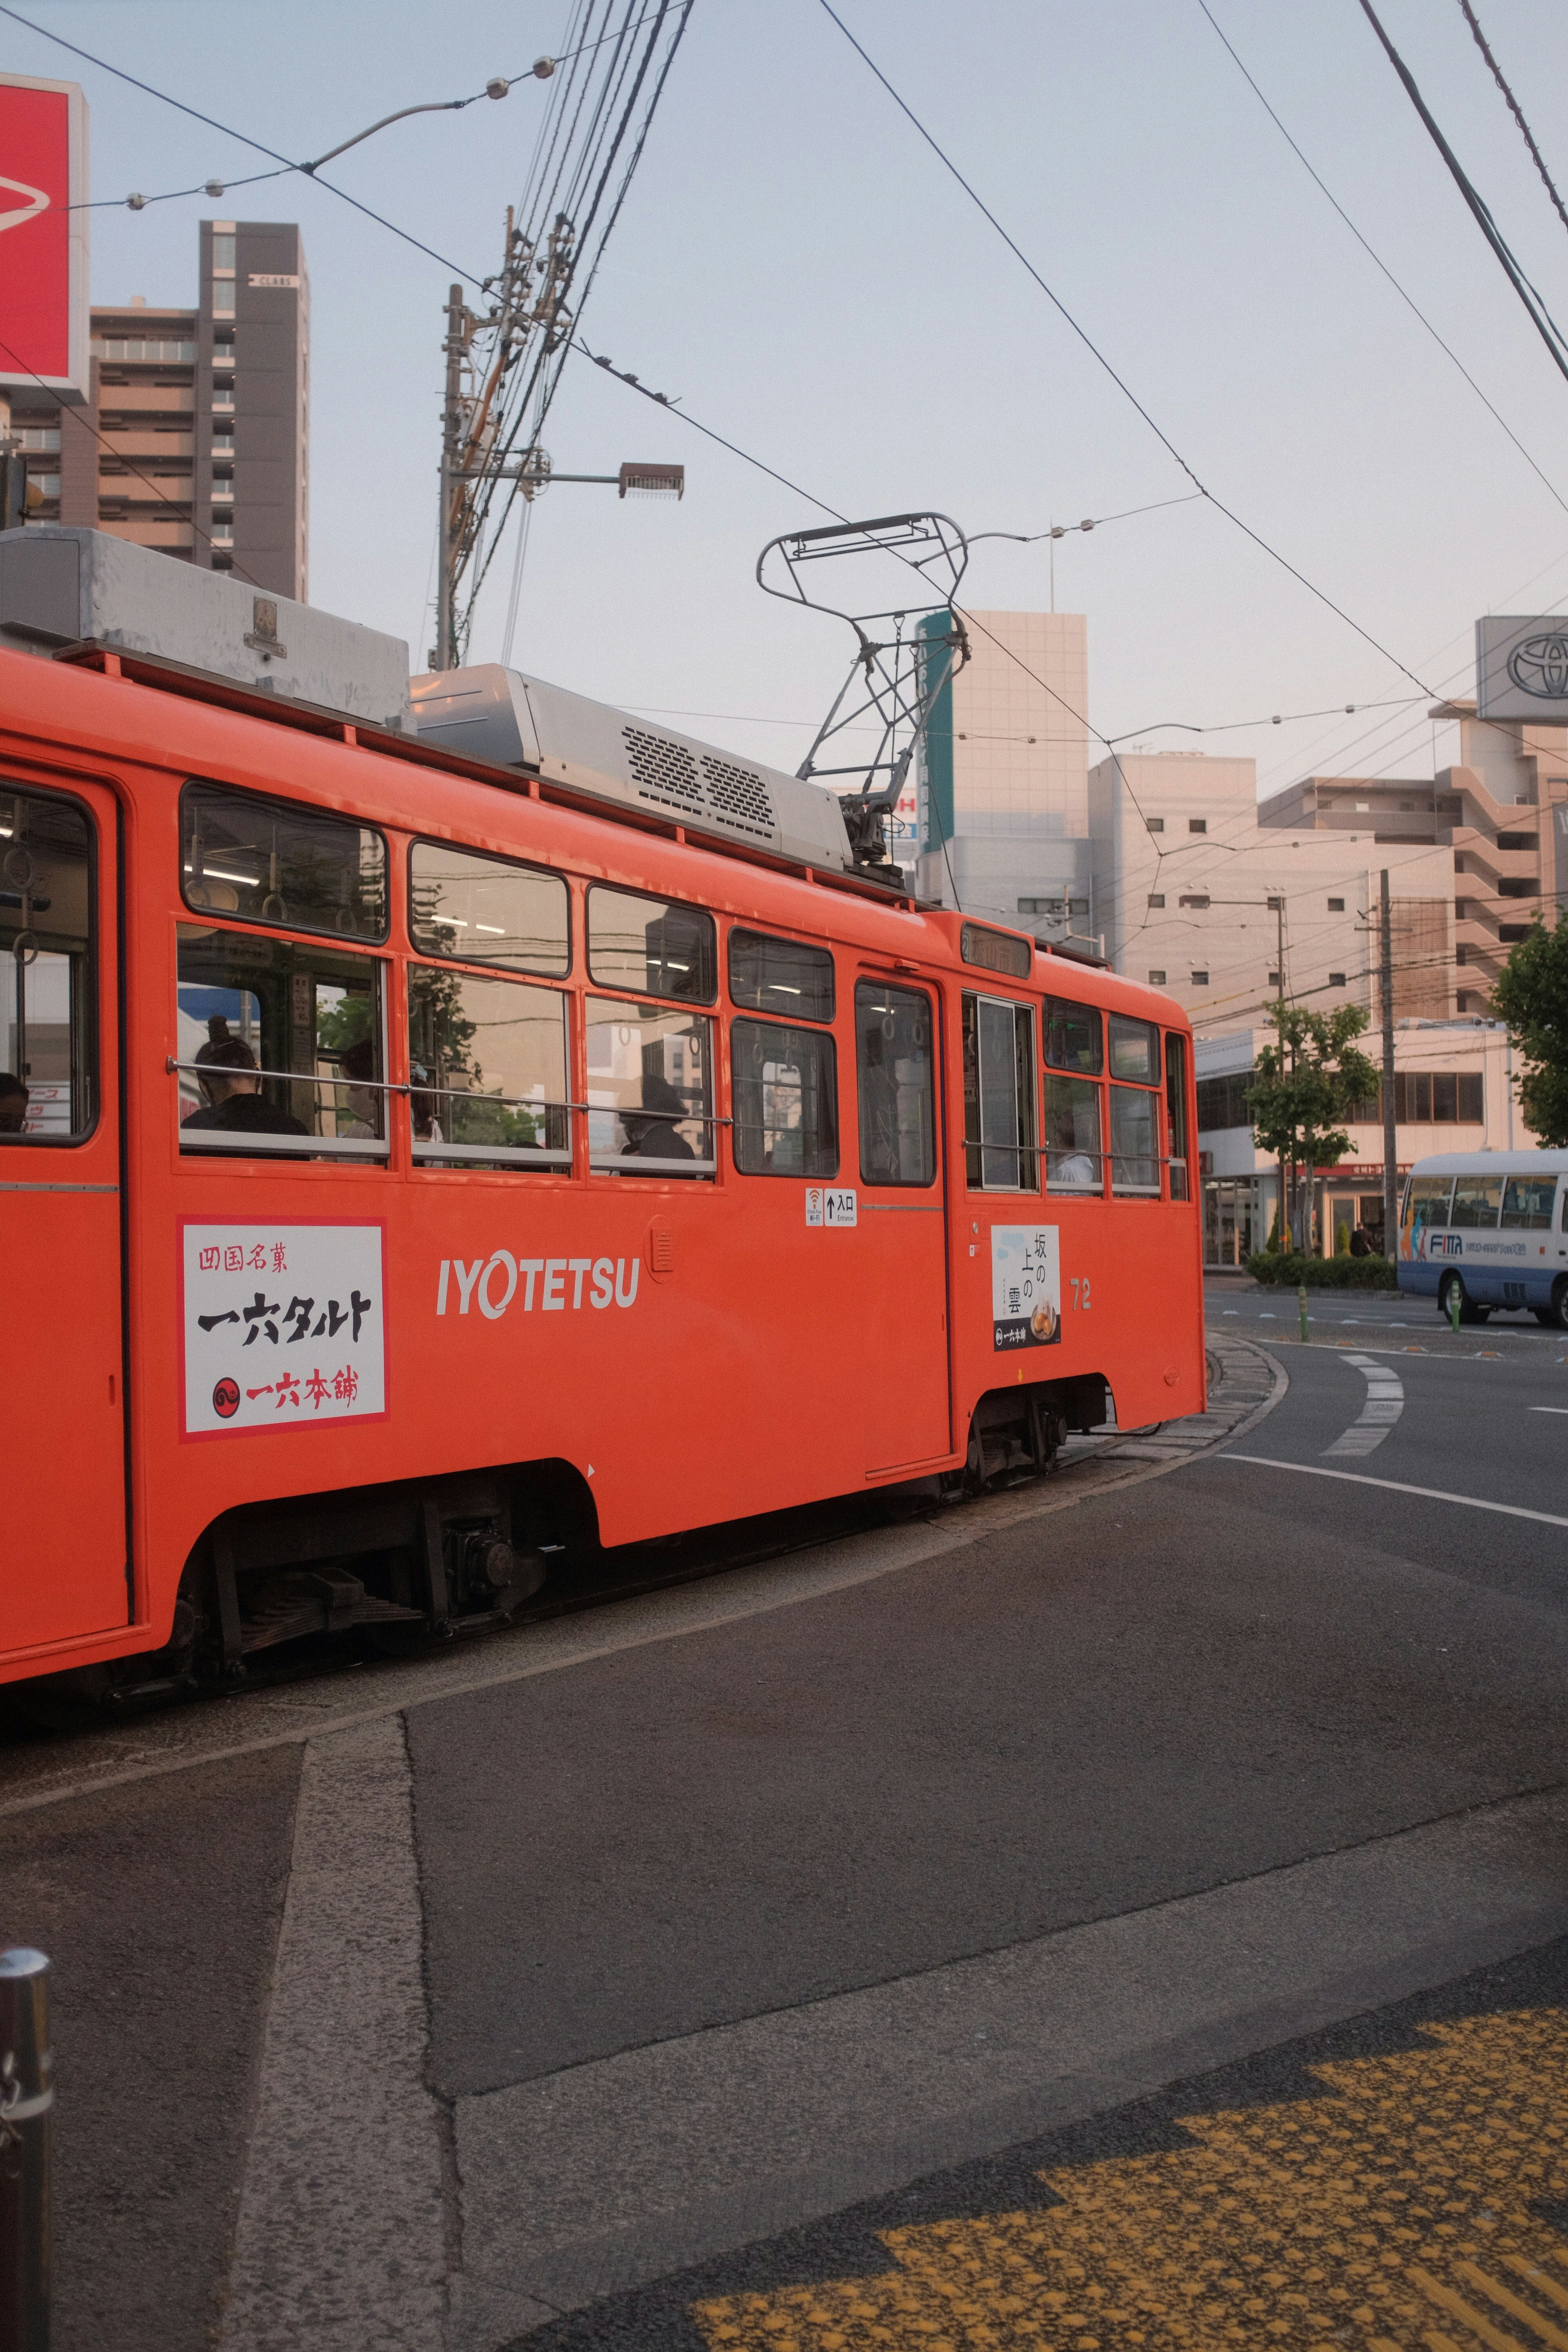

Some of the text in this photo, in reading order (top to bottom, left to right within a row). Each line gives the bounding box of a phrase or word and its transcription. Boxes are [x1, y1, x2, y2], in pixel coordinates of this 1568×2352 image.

[837, 1195, 853, 1211] 入口
[199, 1242, 287, 1272] 四国名菓
[436, 1249, 640, 1320] IYOTETSU
[1070, 1278, 1091, 1311] 72
[198, 1290, 372, 1346] 一六タルト
[246, 1365, 358, 1410] 一六本舗
